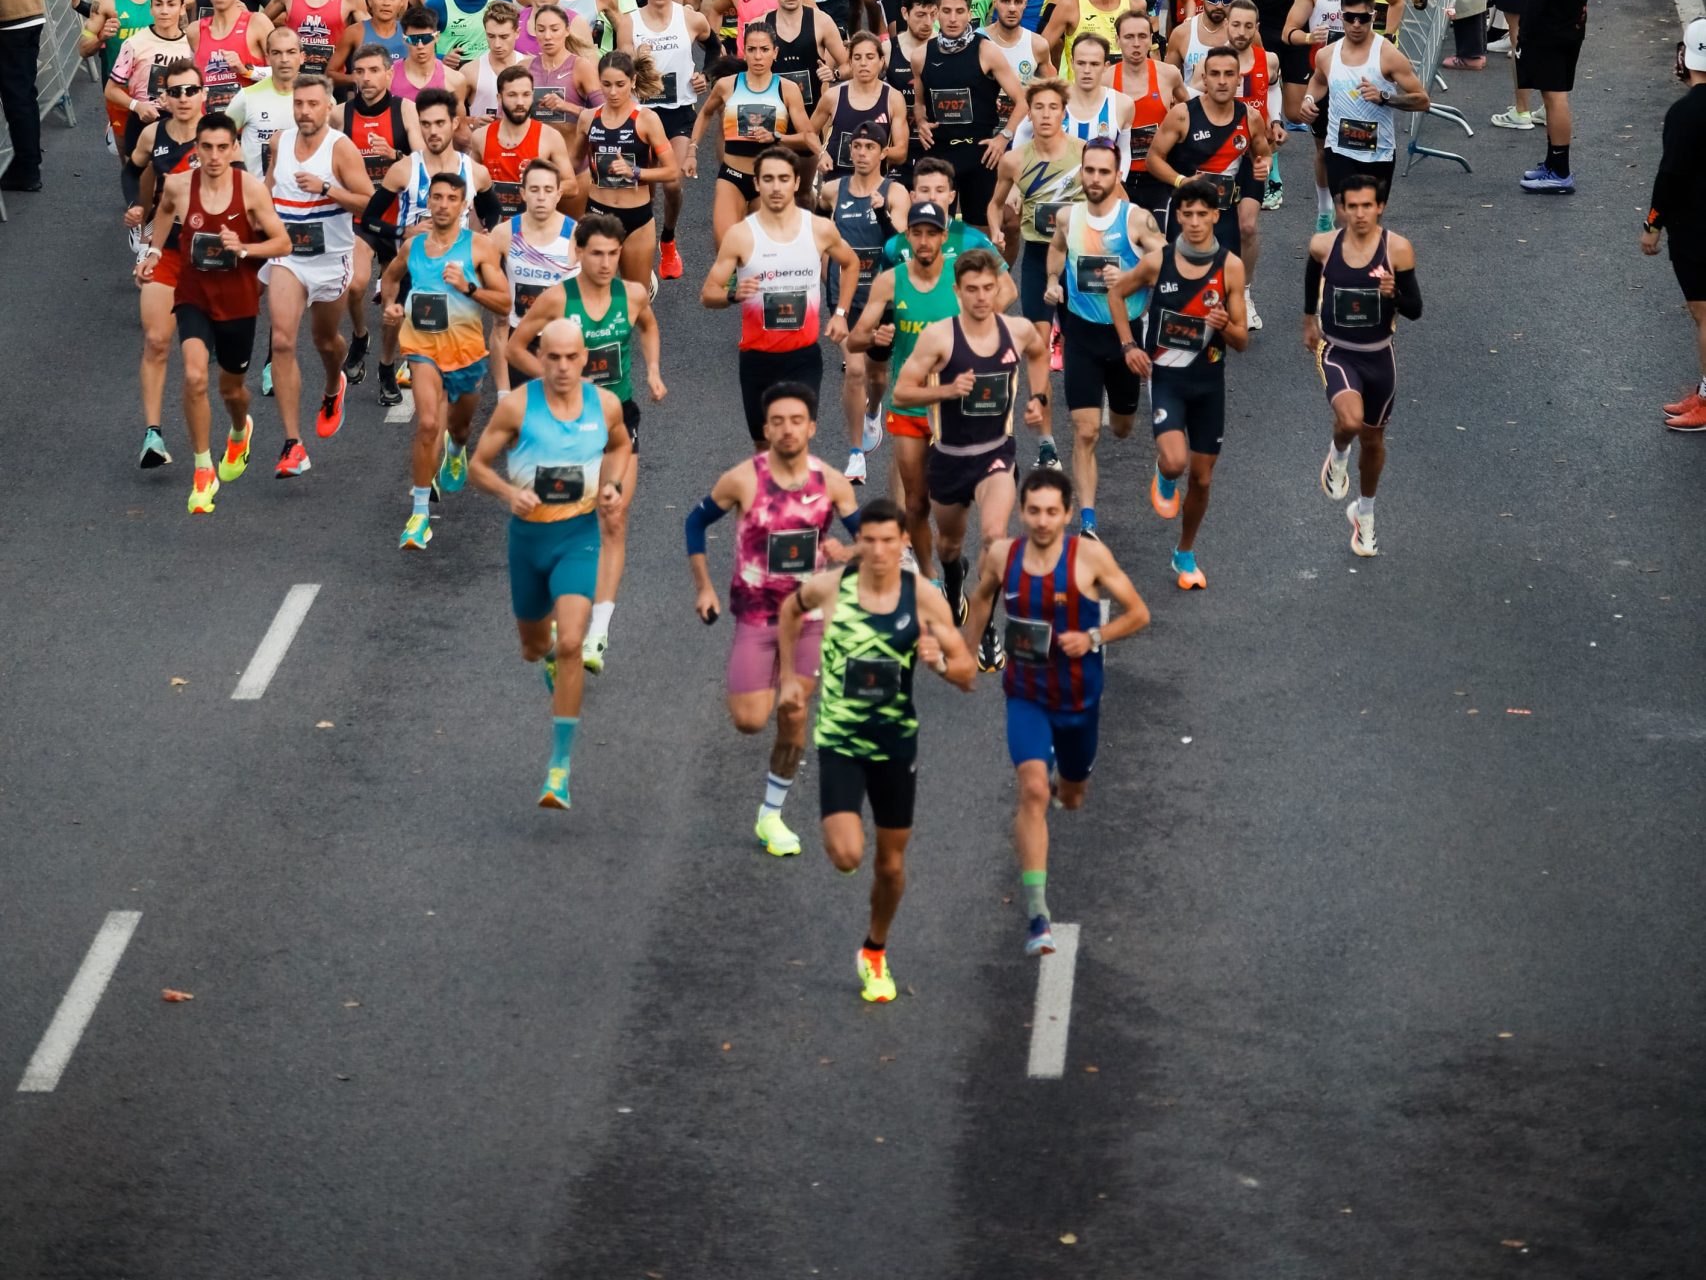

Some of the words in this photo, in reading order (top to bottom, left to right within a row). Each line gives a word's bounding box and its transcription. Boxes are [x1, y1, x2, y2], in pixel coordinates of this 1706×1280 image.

[205, 74, 218, 83] LOS
[217, 72, 238, 83] LUNES
[1192, 130, 1212, 142] CAG
[153, 145, 169, 157] CAG
[514, 265, 551, 280] asisa
[1160, 281, 1179, 294] CAG
[778, 303, 795, 315] 11
[983, 388, 991, 400] 2
